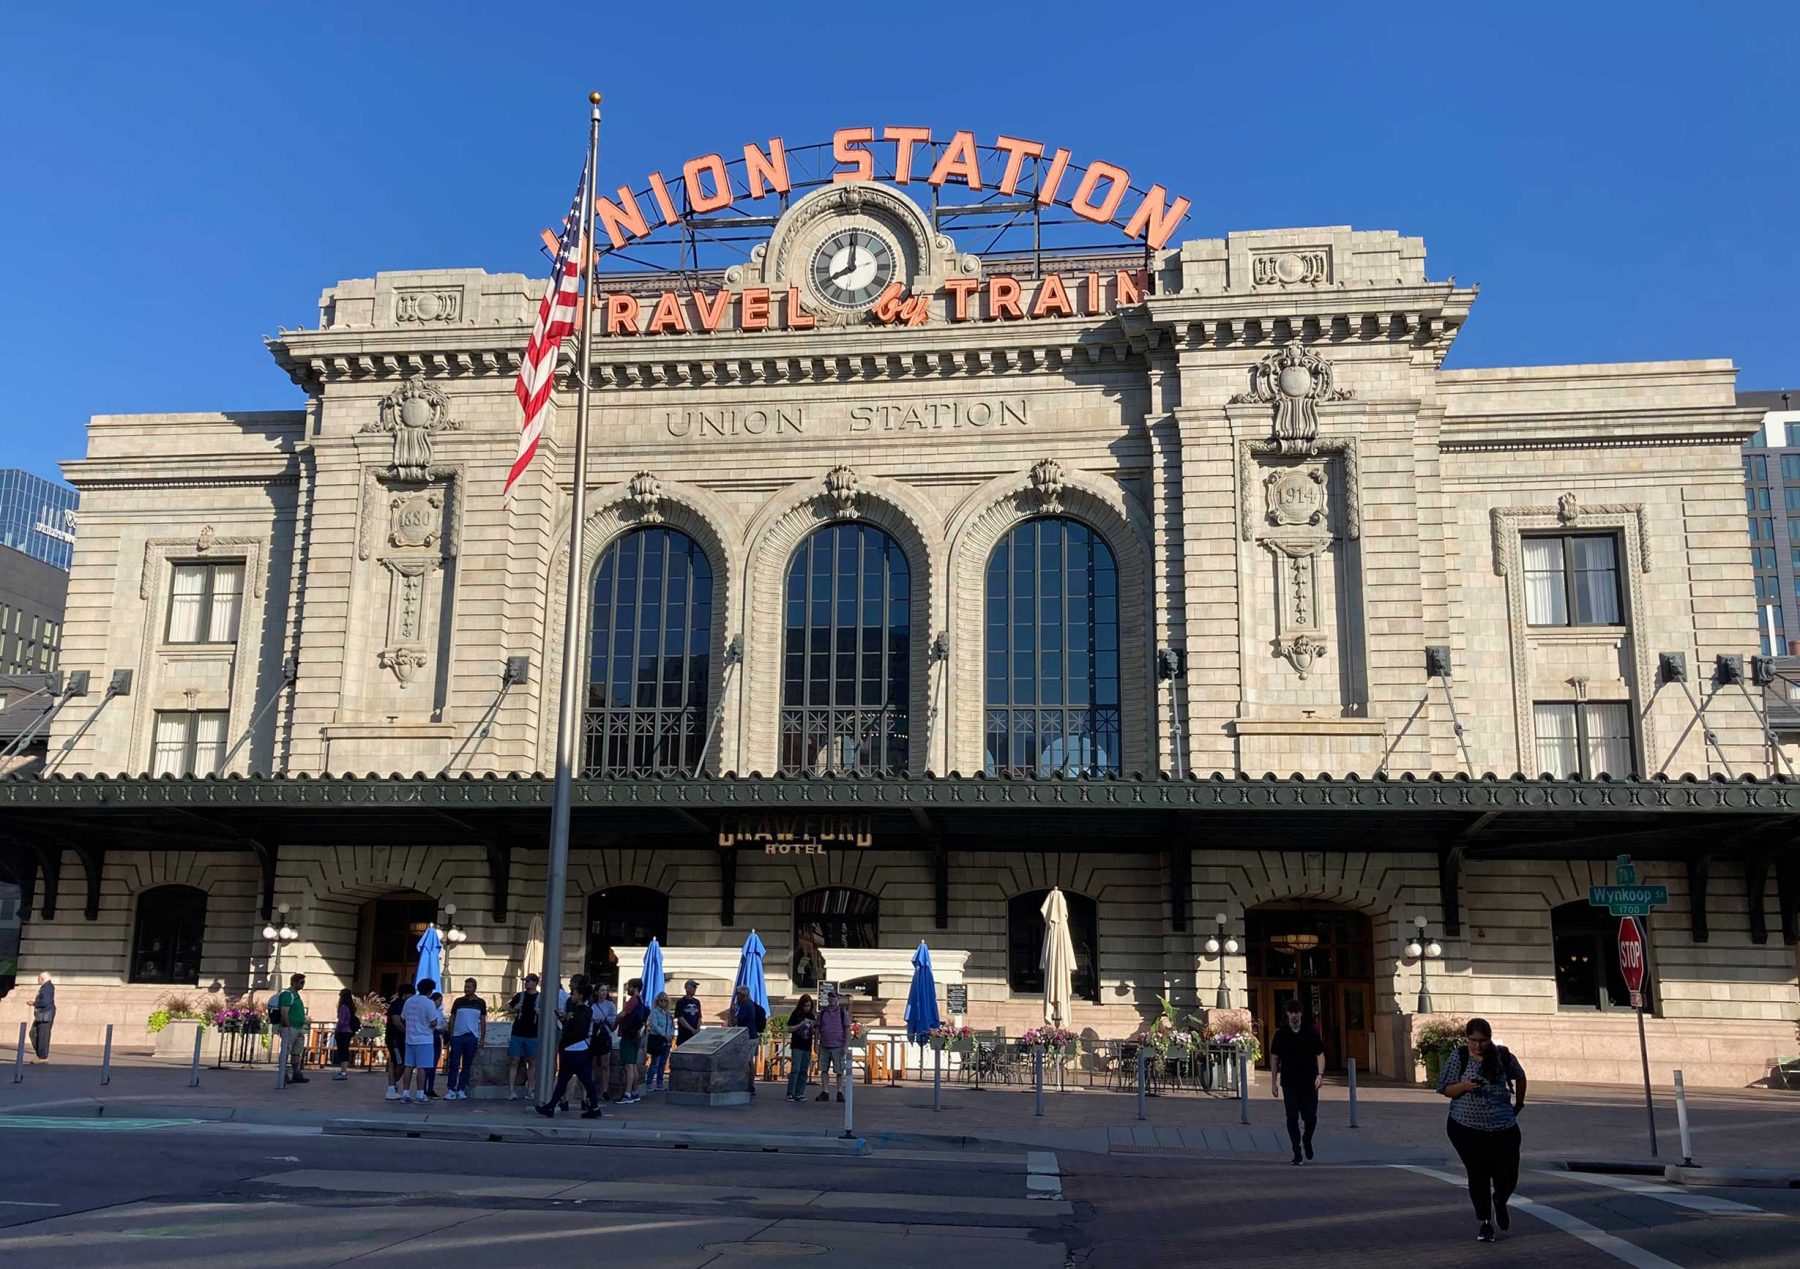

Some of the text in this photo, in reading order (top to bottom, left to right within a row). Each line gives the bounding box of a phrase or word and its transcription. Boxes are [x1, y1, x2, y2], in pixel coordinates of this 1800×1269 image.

[831, 127, 1191, 251] STATION
[871, 282, 927, 326] by
[945, 271, 1148, 321] TRAIN
[667, 400, 1031, 437] UNION STATION
[1278, 487, 1316, 504] 1914
[765, 844, 826, 855] HOTEL
[1594, 888, 1652, 902] Wynkoop
[1619, 906, 1640, 914] 1700
[1620, 941, 1642, 967] STOP
